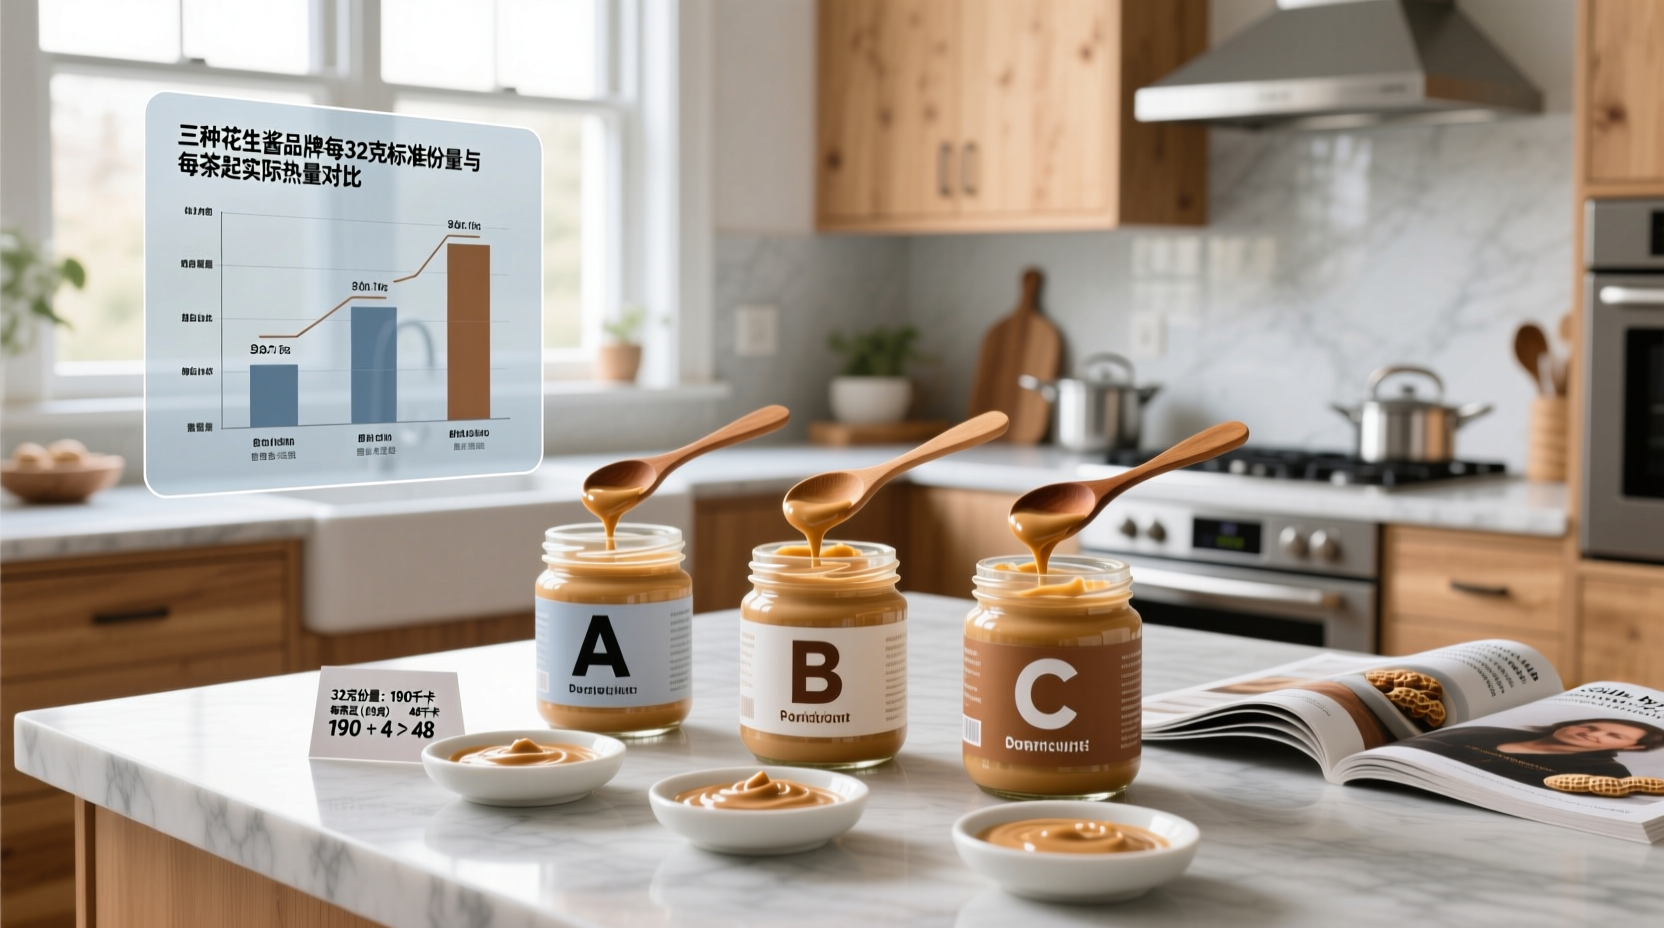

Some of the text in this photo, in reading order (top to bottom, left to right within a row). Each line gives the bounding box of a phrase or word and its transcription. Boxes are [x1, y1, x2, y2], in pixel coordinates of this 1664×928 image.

[178, 123, 481, 172] 三种花生酱品牌每32克标准份量与
[572, 614, 631, 678] A
[792, 640, 843, 704] B
[1014, 657, 1078, 731] C
[328, 719, 362, 737] 190
[380, 720, 393, 738] 4
[411, 721, 435, 739] 48
